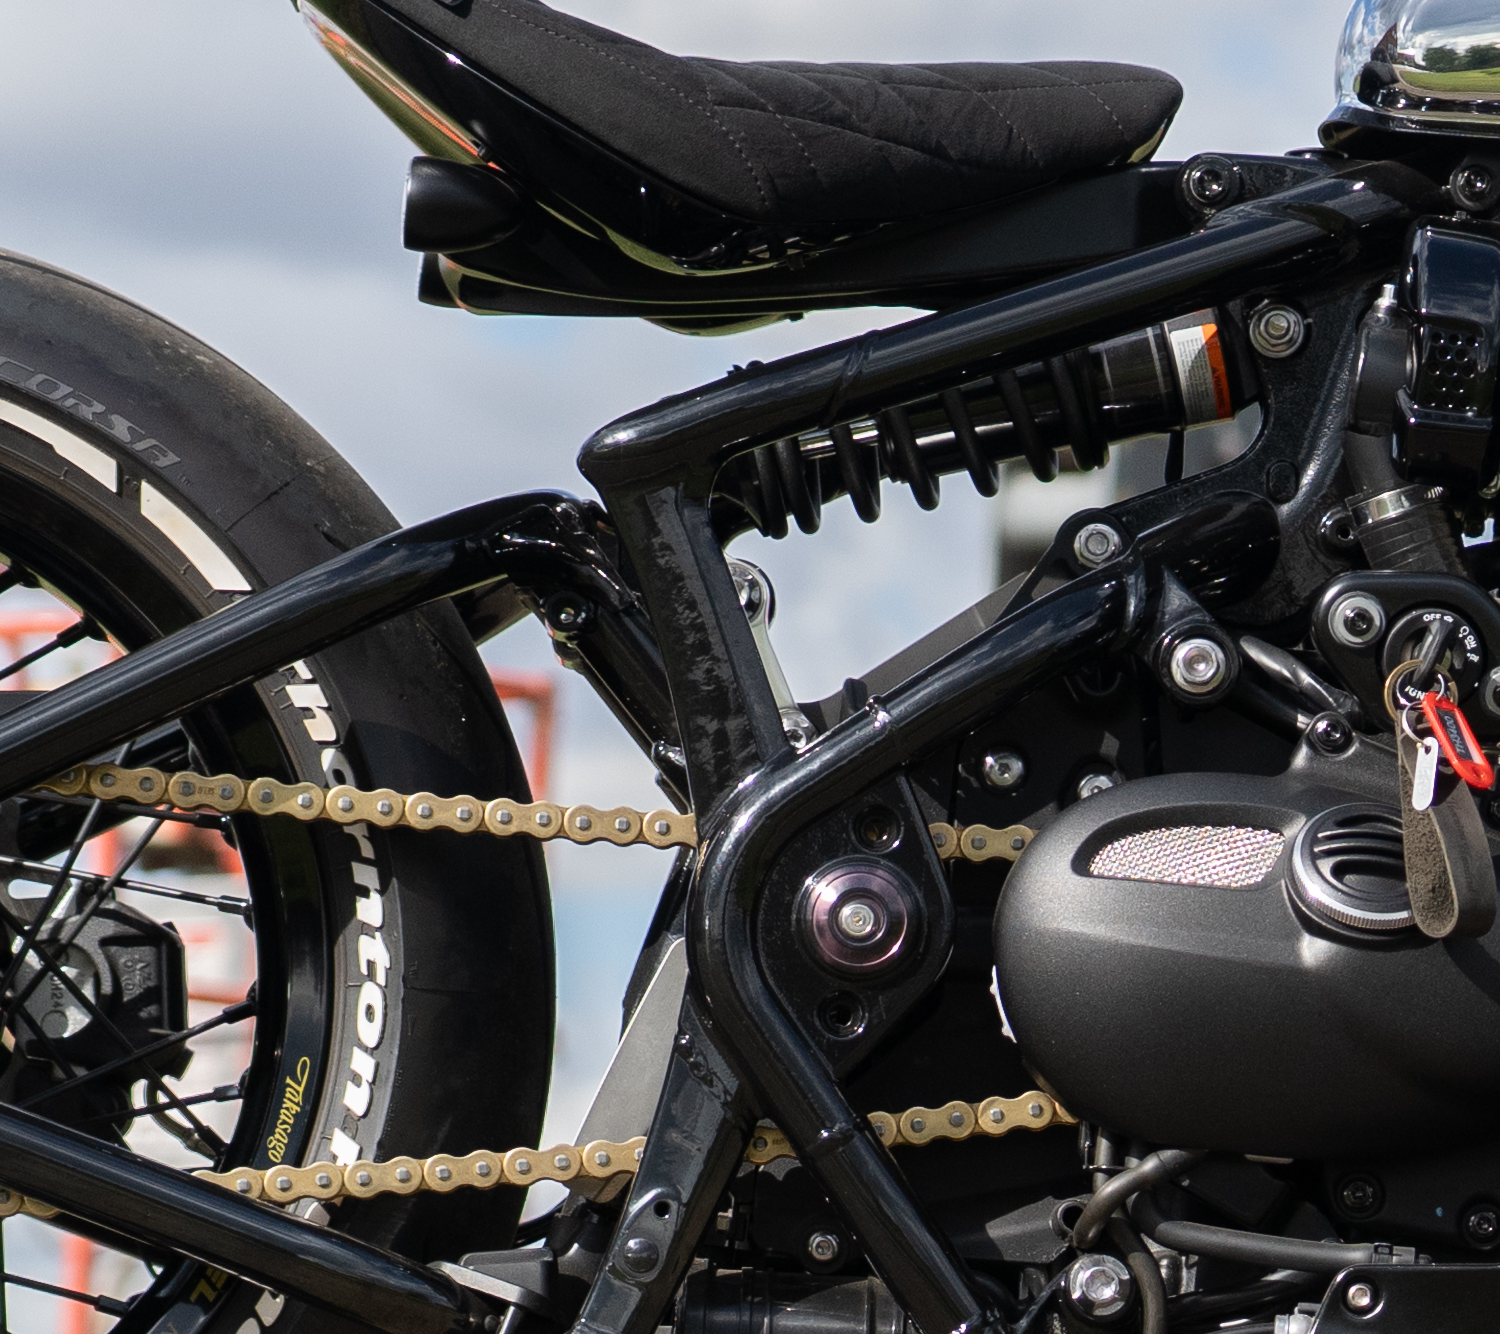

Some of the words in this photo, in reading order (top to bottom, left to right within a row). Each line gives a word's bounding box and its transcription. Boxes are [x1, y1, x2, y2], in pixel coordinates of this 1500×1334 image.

[1423, 613, 1441, 622] OFF
[1466, 634, 1478, 649] ON
[266, 1056, 310, 1164] Takasago
